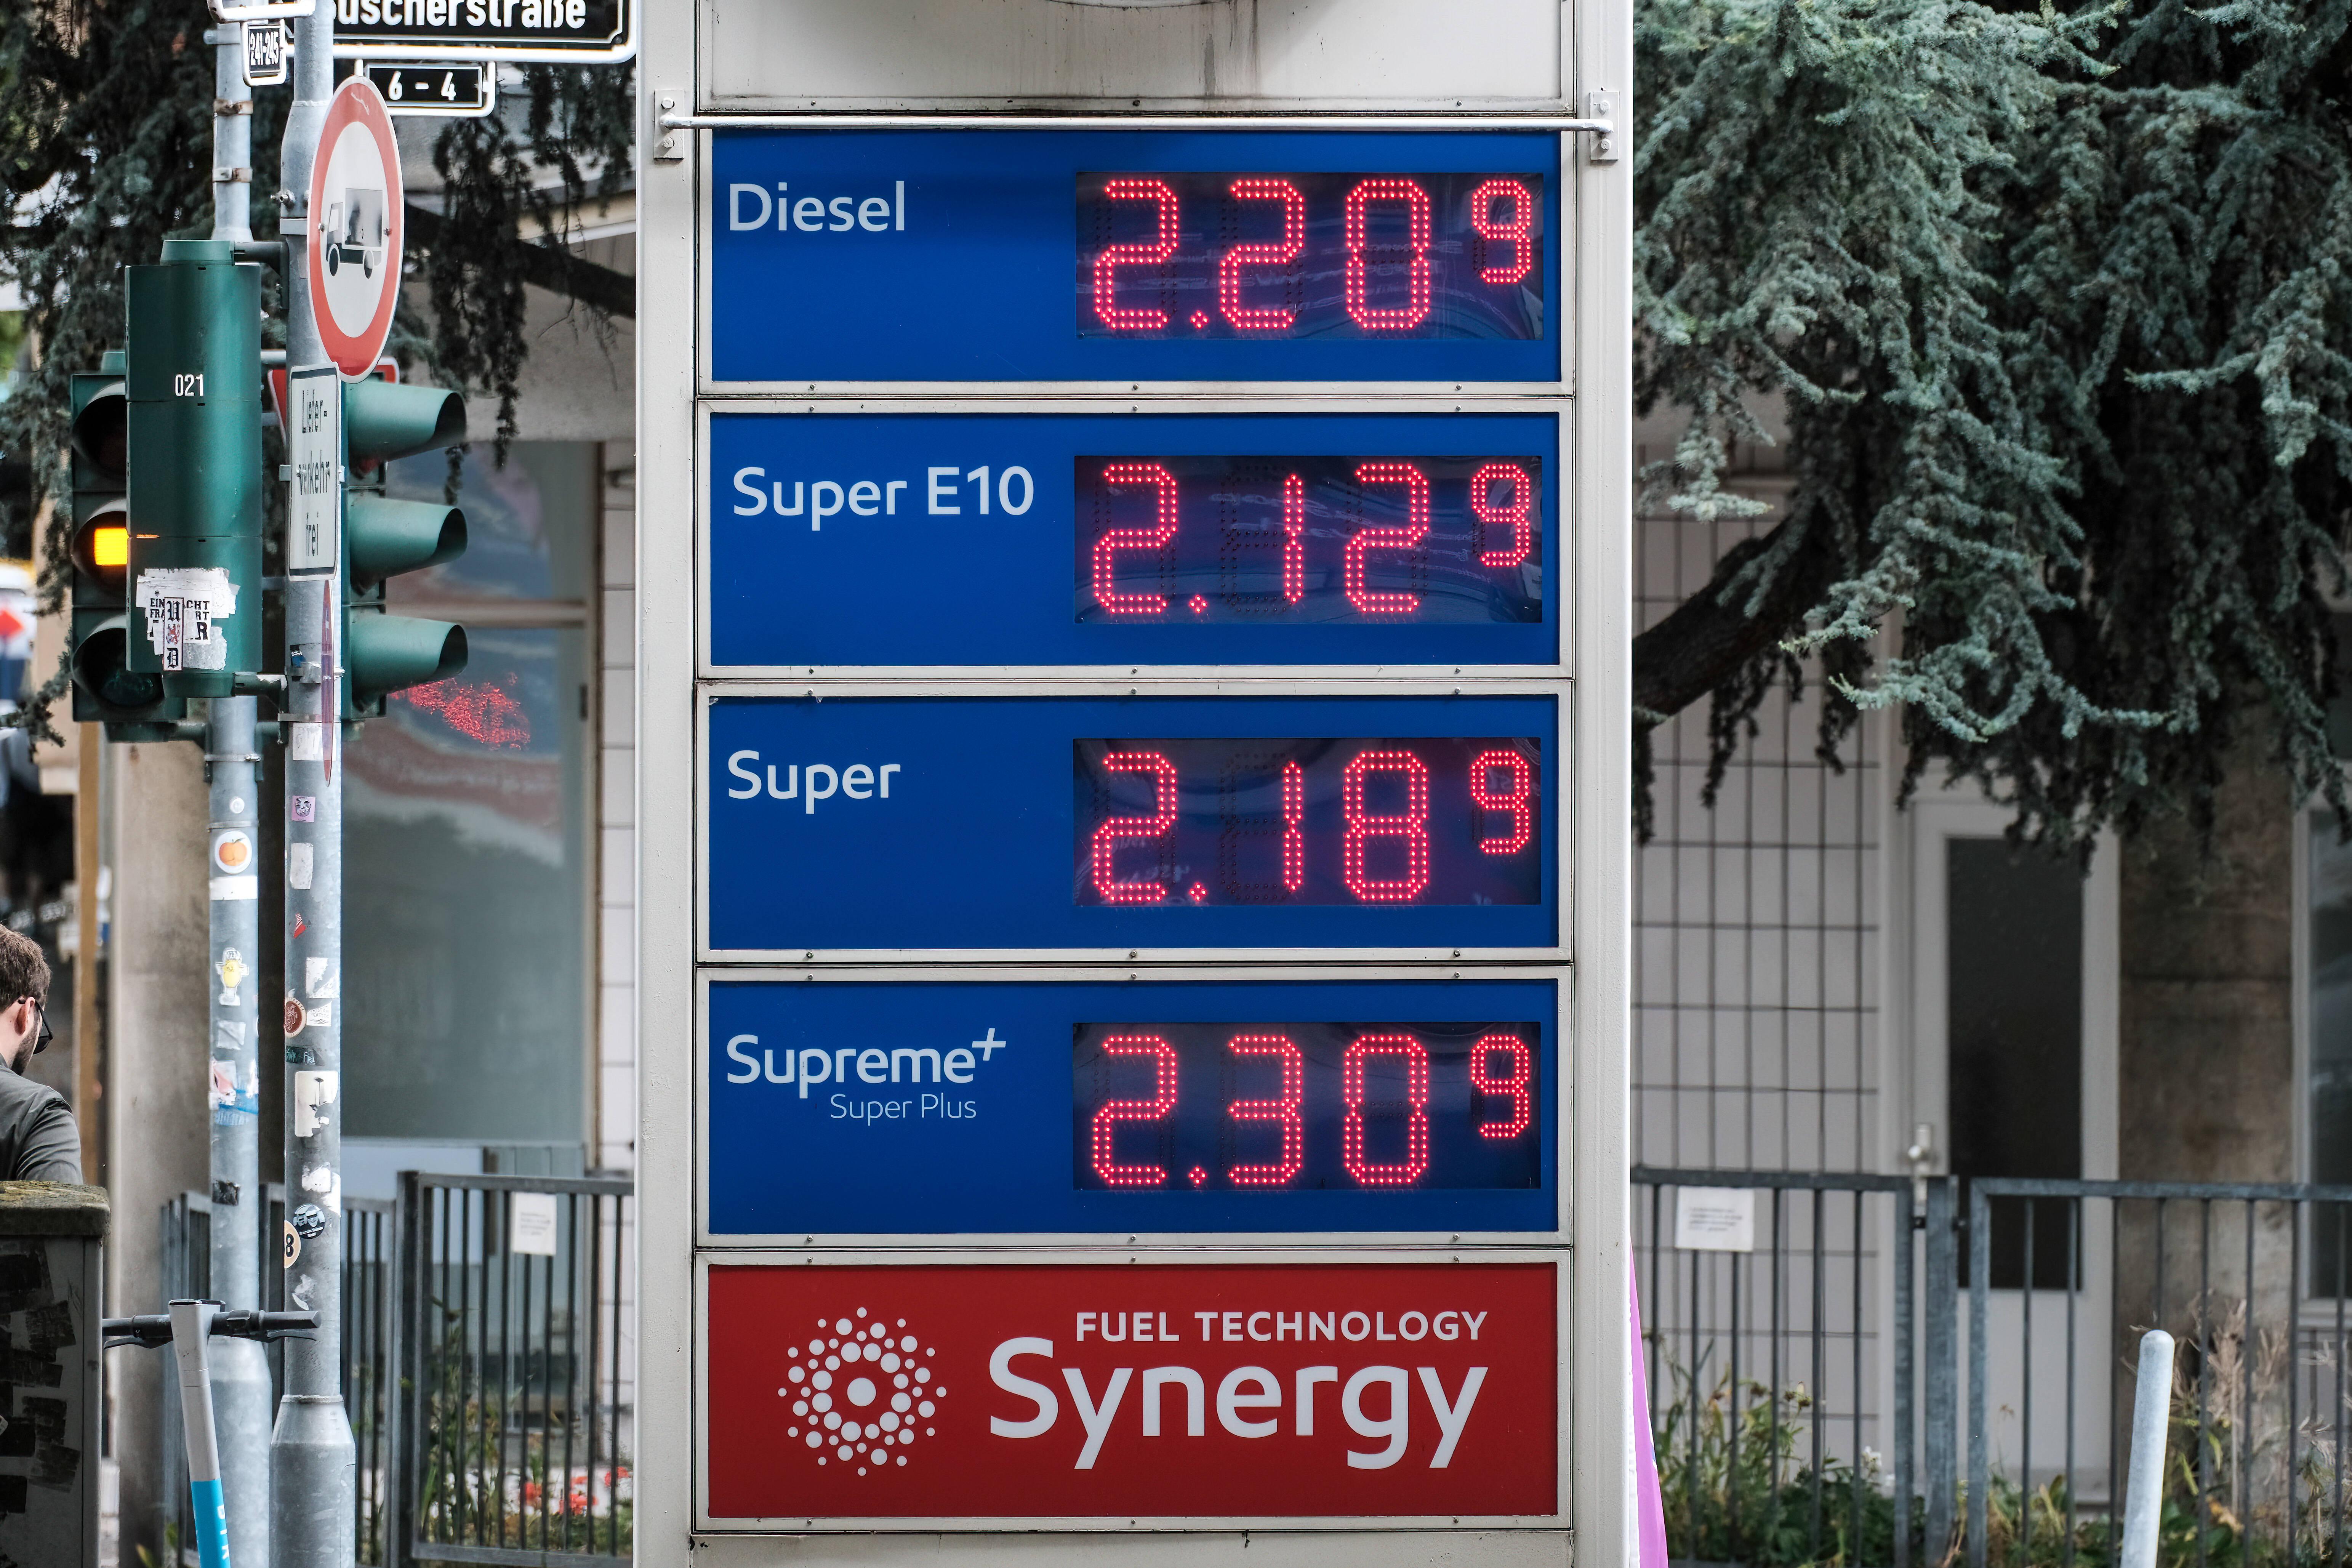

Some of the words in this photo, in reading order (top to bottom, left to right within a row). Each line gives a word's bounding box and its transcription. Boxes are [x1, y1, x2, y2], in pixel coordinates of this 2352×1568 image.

[334, 0, 586, 29] uscherstraße
[250, 31, 279, 66] 241-245
[388, 71, 403, 101] 6
[440, 71, 456, 101] 4
[730, 181, 905, 232] Diesel
[175, 373, 204, 396] 021
[733, 467, 907, 531] Super
[928, 466, 1034, 516] E10
[306, 511, 319, 556] frei
[728, 750, 901, 814] Super
[831, 1094, 912, 1126] Super
[921, 1092, 976, 1118] Plus
[1076, 1312, 1179, 1342] FUEL
[1194, 1311, 1487, 1342] TECHNOLOGY
[989, 1337, 1488, 1470] Synergy
